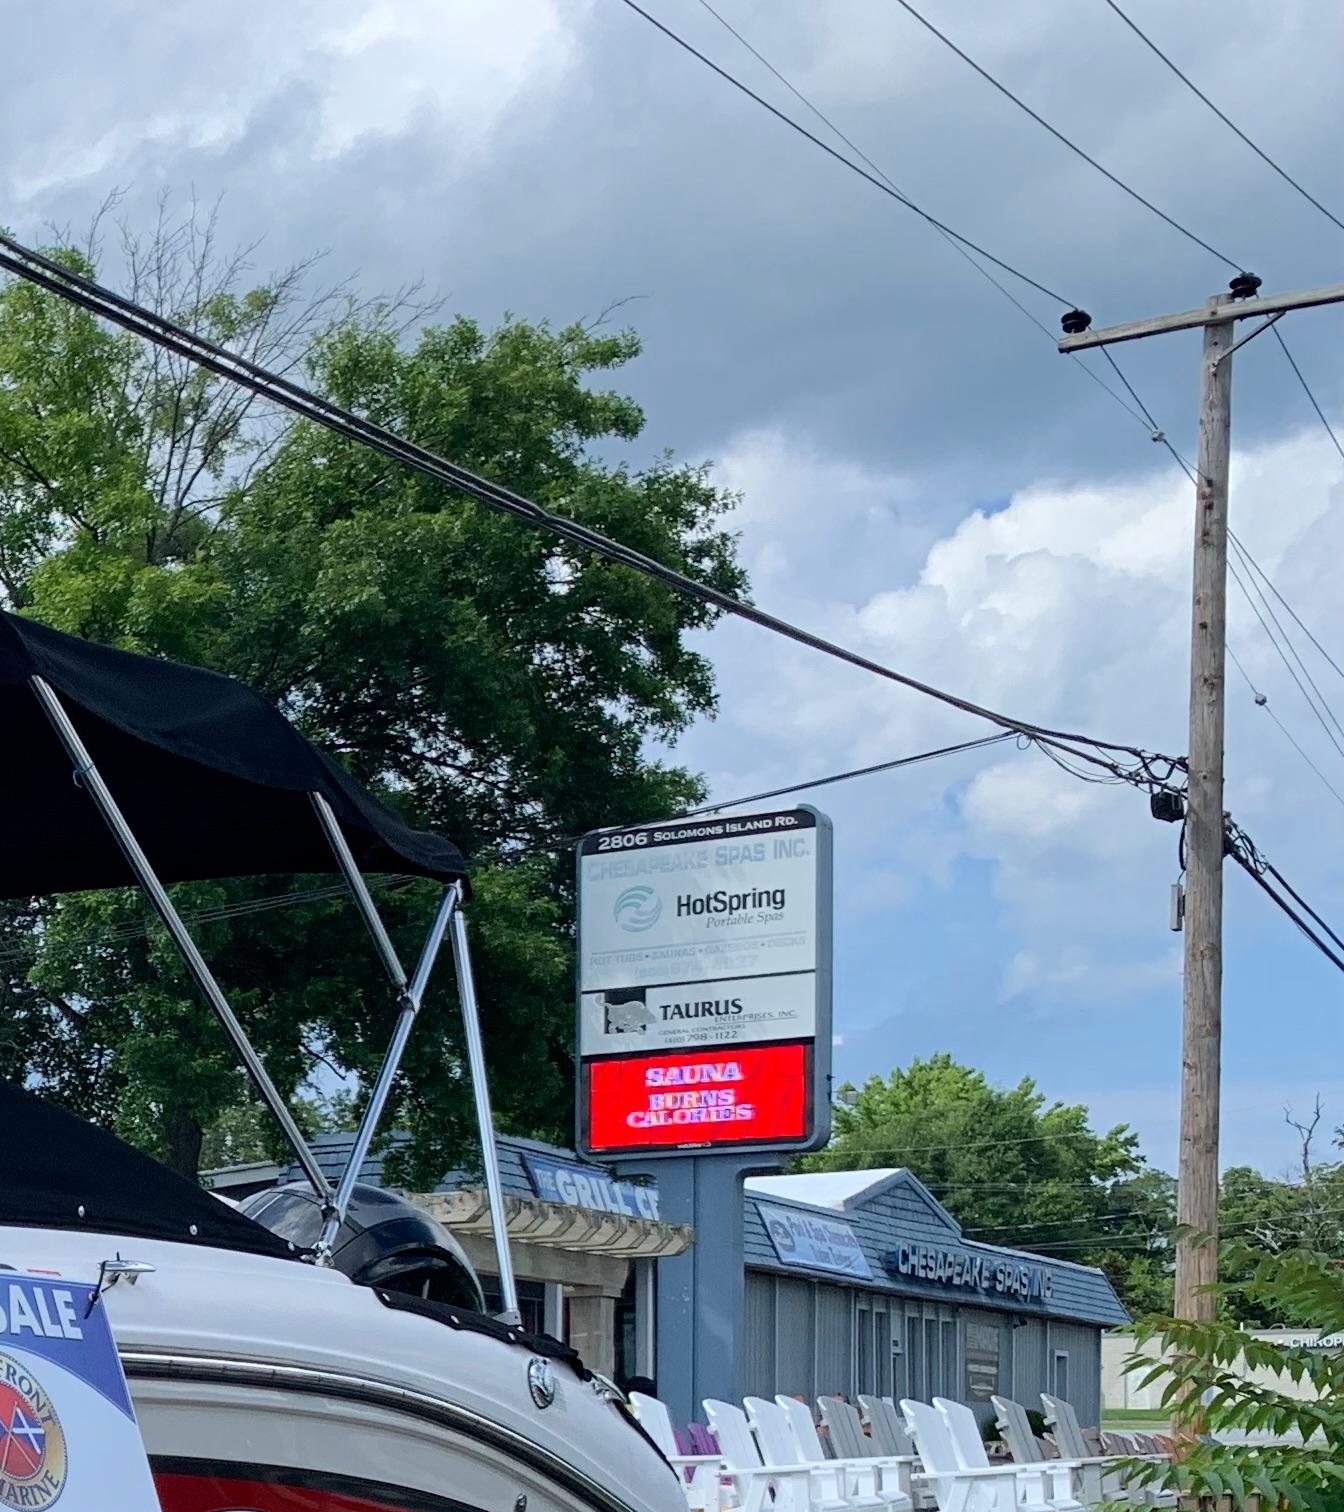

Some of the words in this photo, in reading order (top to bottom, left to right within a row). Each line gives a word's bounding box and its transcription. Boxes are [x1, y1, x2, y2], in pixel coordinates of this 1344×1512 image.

[598, 832, 648, 851] 2806
[653, 825, 724, 842] SOLOMONS
[725, 819, 773, 833] ISLAND
[774, 815, 798, 828] RD.
[715, 843, 766, 867] SPAS
[773, 838, 810, 860] INC.
[677, 887, 785, 916] HotSpring
[706, 912, 754, 929] Portable
[756, 910, 785, 925] Spas
[660, 998, 743, 1021] TAURUS
[645, 1062, 744, 1087] SAUNA
[649, 1089, 736, 1111] BURNS
[626, 1104, 755, 1129] CALORIES
[555, 1169, 633, 1216] GRILL
[898, 1242, 990, 1288] CHESAPEAKE
